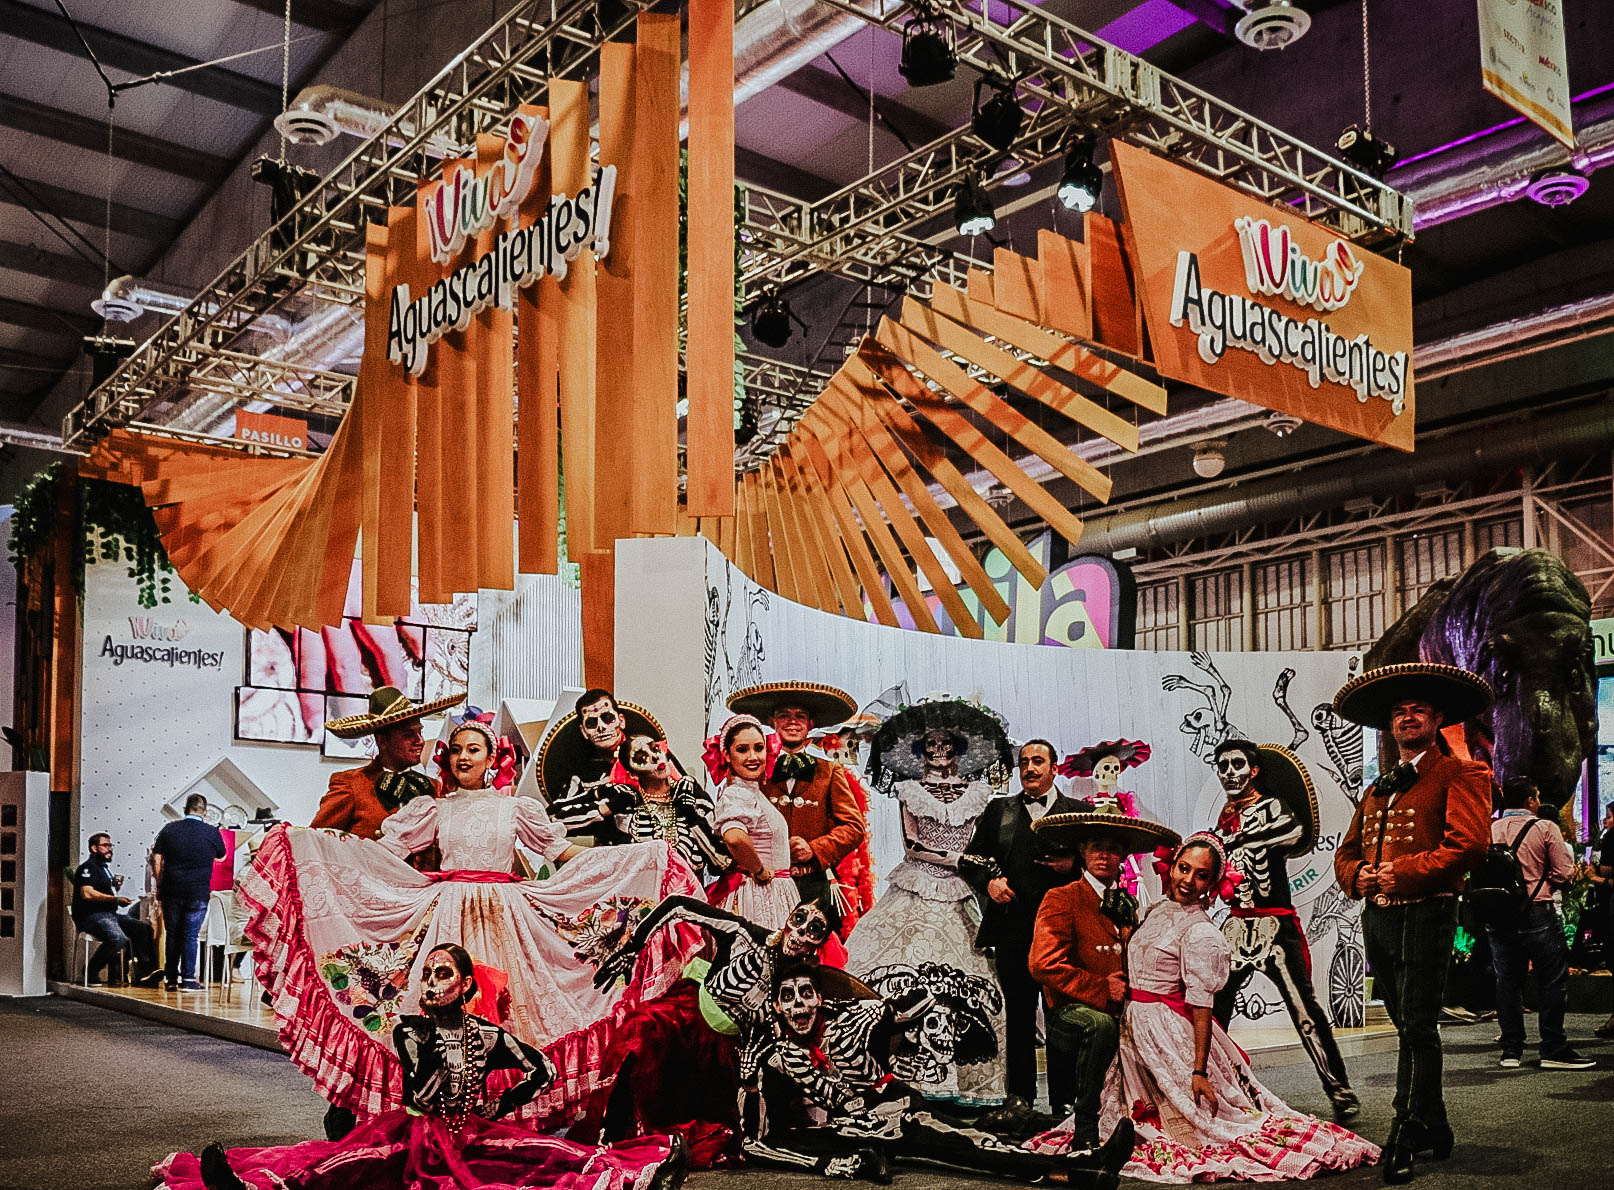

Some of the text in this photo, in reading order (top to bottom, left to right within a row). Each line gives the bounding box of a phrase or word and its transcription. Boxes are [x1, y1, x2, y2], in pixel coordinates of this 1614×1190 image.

[386, 165, 604, 372] Aguascalientes!
[1180, 252, 1409, 411] Aguascalientes!
[241, 428, 302, 448] PASILLO
[100, 635, 225, 671] Aguascalientes!
